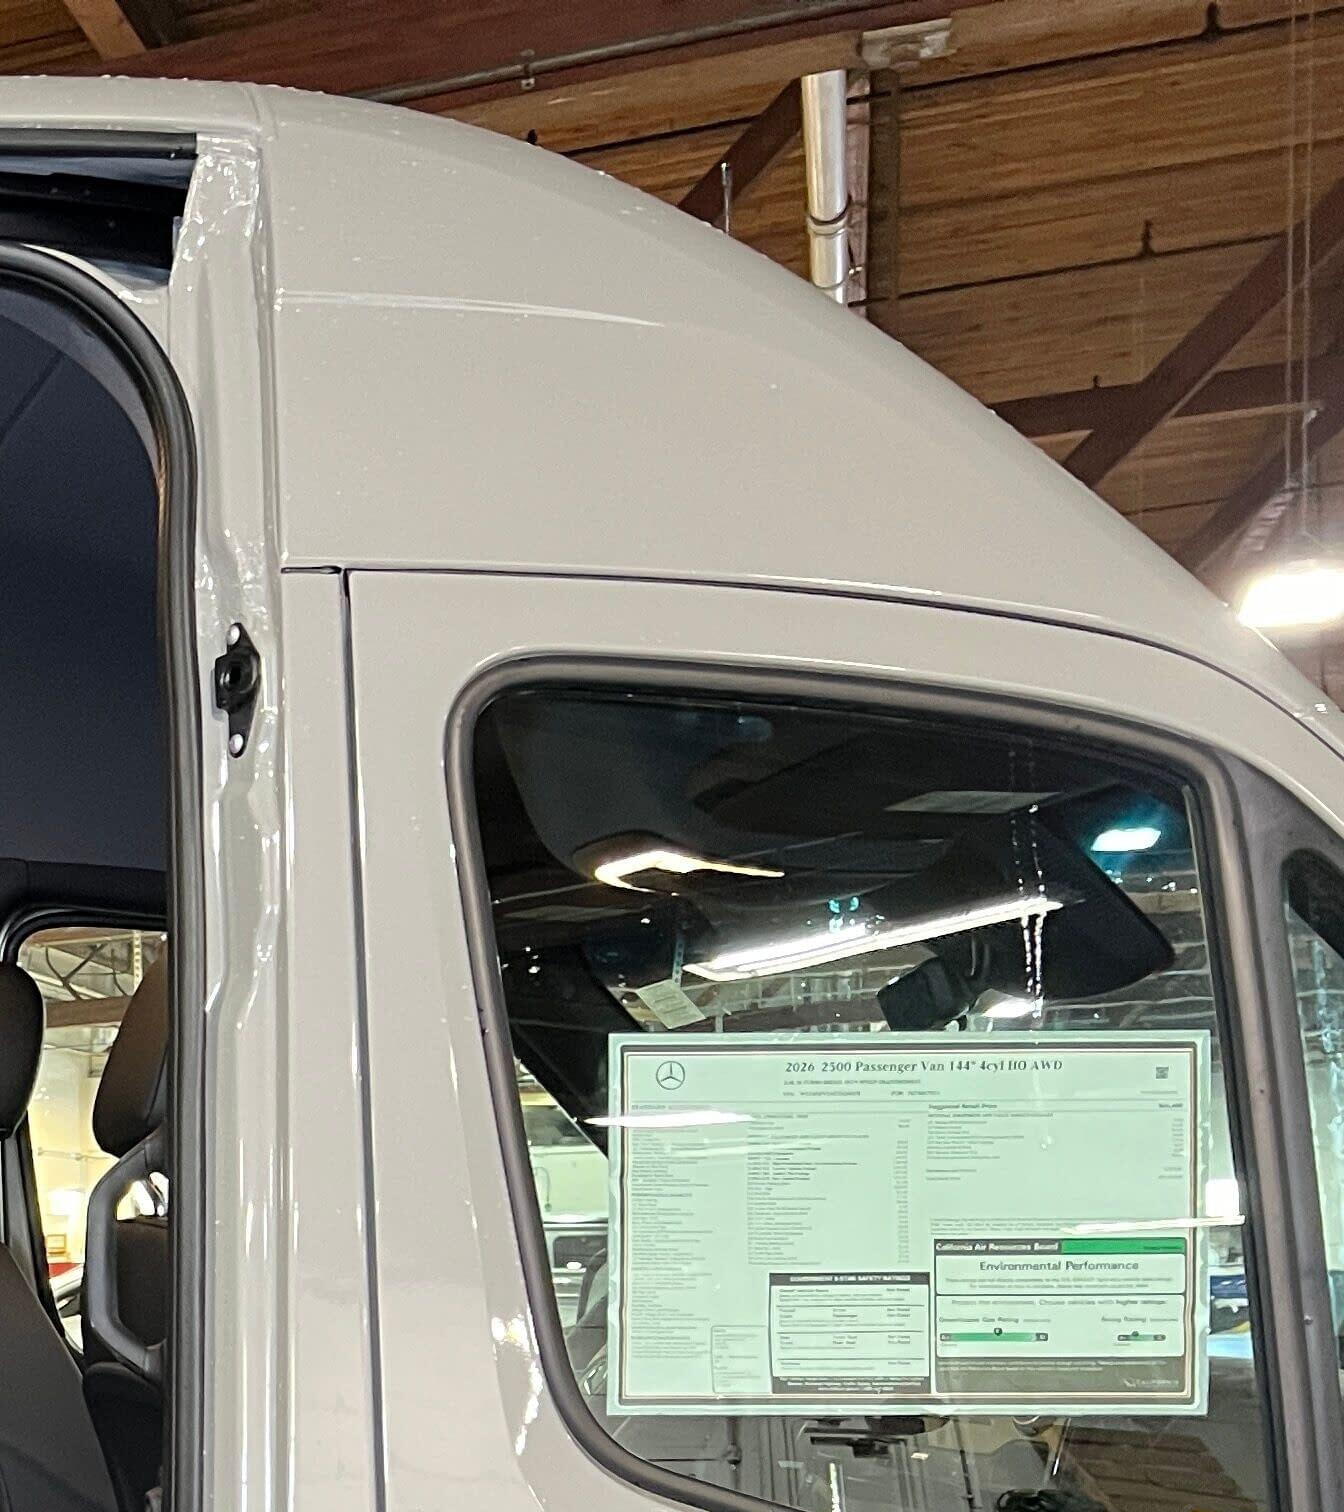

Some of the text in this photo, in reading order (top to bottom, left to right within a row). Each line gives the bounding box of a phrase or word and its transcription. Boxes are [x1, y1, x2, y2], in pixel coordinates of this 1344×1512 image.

[785, 1062, 815, 1073] 2026
[821, 1061, 852, 1073] 2500
[855, 1060, 918, 1074] Passenger
[921, 1060, 945, 1072] Van
[1031, 1059, 1063, 1071] AWD
[979, 1260, 1139, 1271] Environmental Performance
